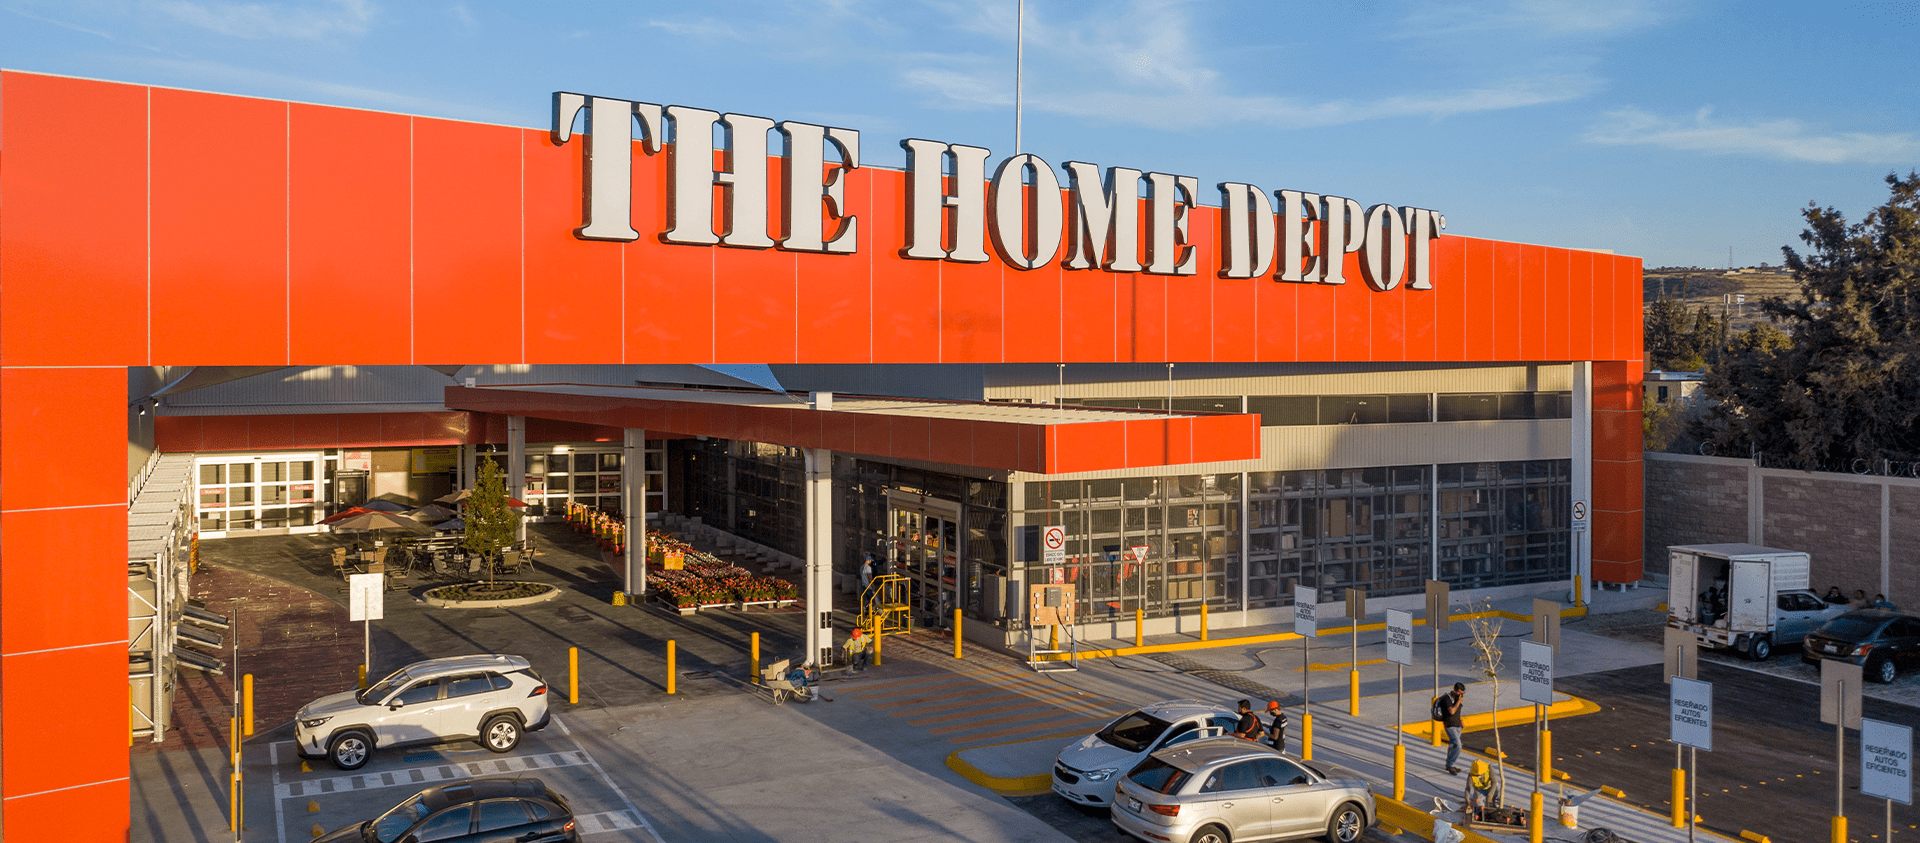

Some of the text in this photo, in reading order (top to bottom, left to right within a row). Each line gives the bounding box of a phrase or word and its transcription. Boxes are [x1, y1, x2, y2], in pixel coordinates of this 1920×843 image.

[551, 91, 1441, 292] THE HOME DEPOT
[1296, 601, 1315, 611] RESERVADO
[1296, 612, 1315, 622] EFICIENTES
[1388, 625, 1410, 636] RESERVADO
[1388, 637, 1410, 648] EFICIENTES
[1392, 633, 1406, 641] AUTOS
[1522, 660, 1550, 672] RESERVADO
[1528, 668, 1545, 678] AUTOS
[1522, 673, 1550, 686] EFICIENTES
[1674, 698, 1708, 712] RESERVADO
[1681, 708, 1701, 718] AUTOS
[1674, 714, 1708, 728] EFICIENTES
[1865, 744, 1907, 760] RESERVADO
[1874, 755, 1898, 767] AUTOS
[1865, 761, 1907, 778] EFICIENTES
